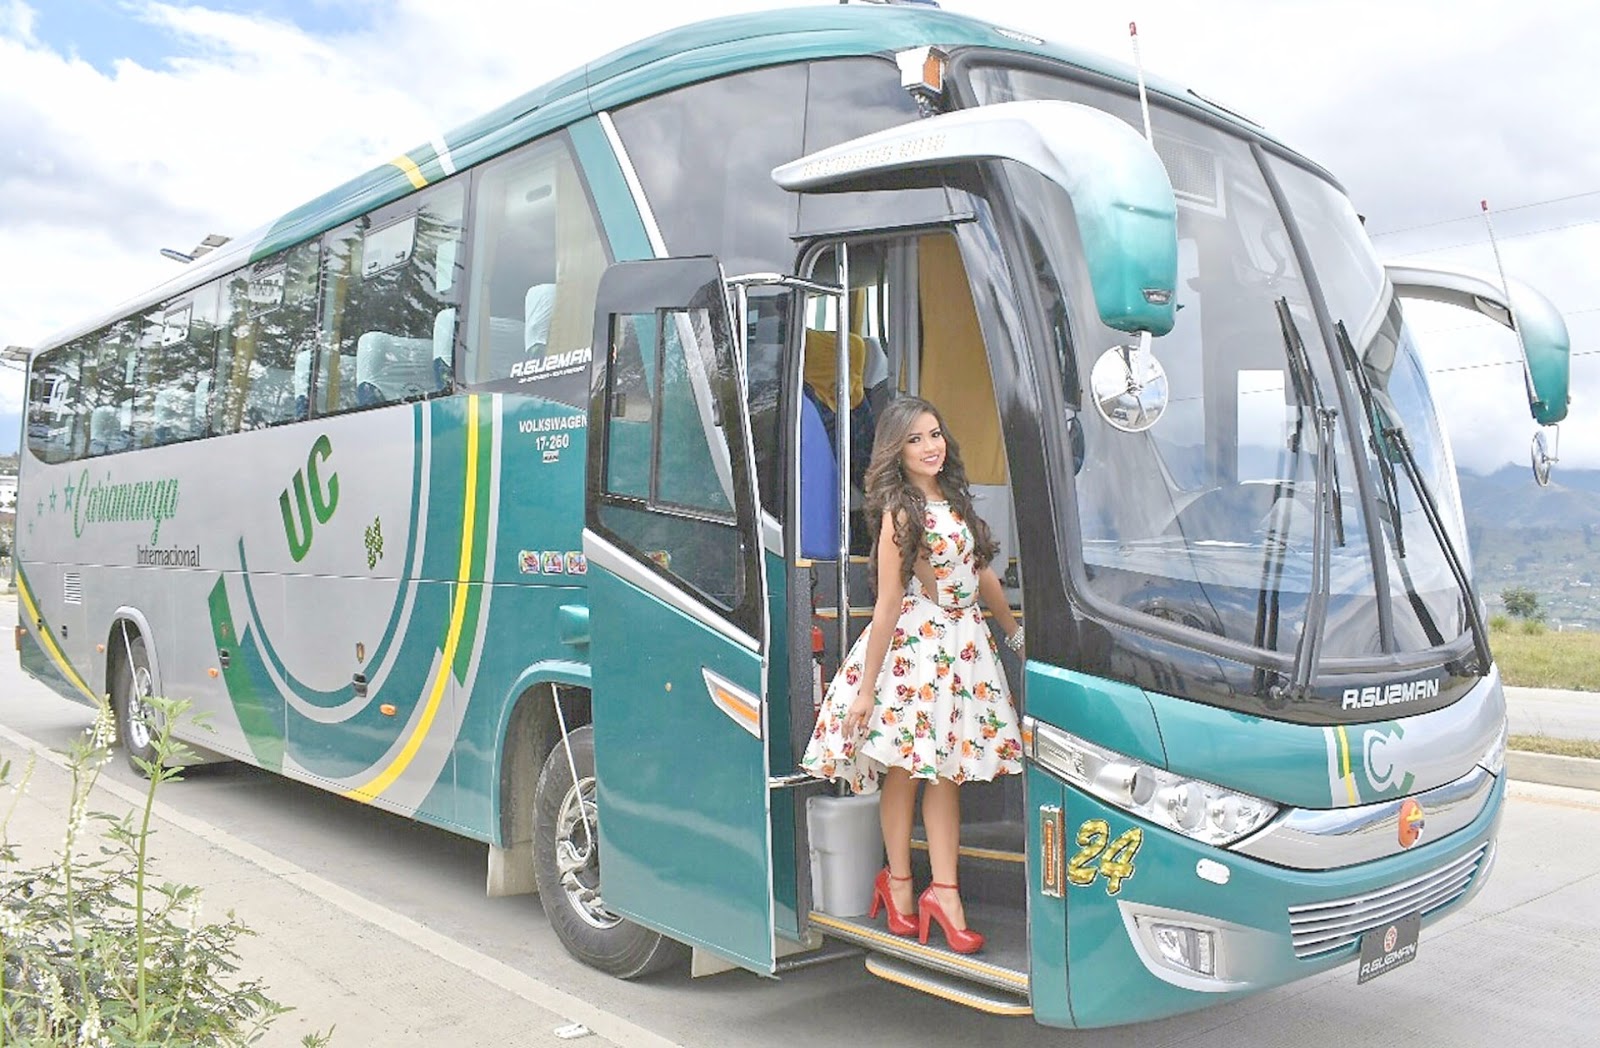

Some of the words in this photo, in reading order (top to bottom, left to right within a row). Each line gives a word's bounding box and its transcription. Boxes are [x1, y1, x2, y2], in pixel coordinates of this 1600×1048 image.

[279, 434, 339, 563] UC
[136, 544, 200, 567] Internacional
[1067, 819, 1143, 896] 24
